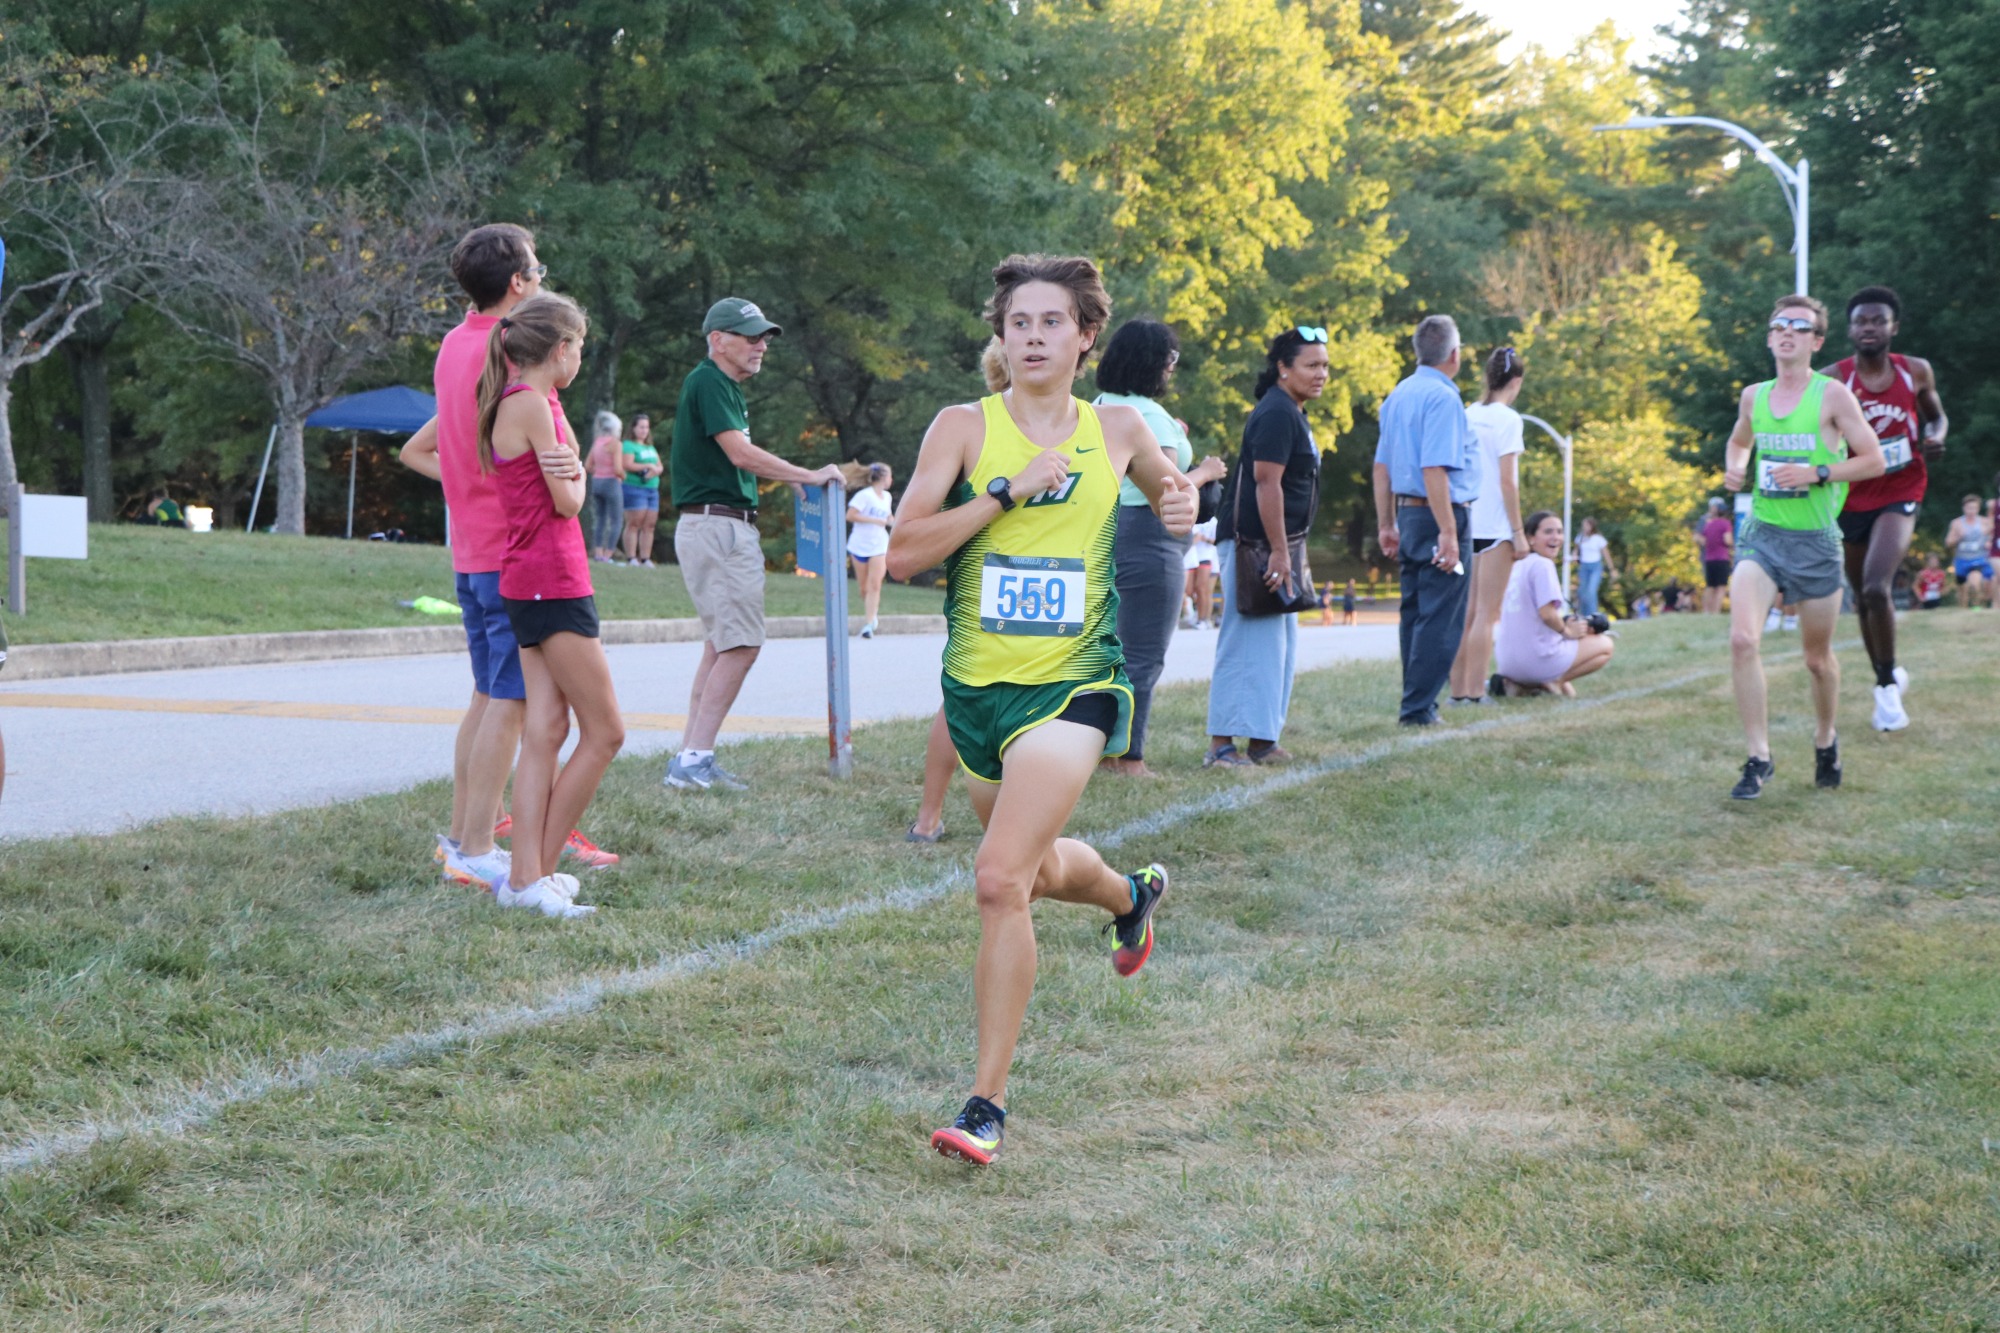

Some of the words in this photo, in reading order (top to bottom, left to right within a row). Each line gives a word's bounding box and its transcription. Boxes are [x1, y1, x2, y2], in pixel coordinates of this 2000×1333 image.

[1754, 432, 1816, 452] TEVENSON
[800, 499, 821, 518] Speed
[800, 520, 820, 548] Bump
[997, 574, 1066, 621] 559
